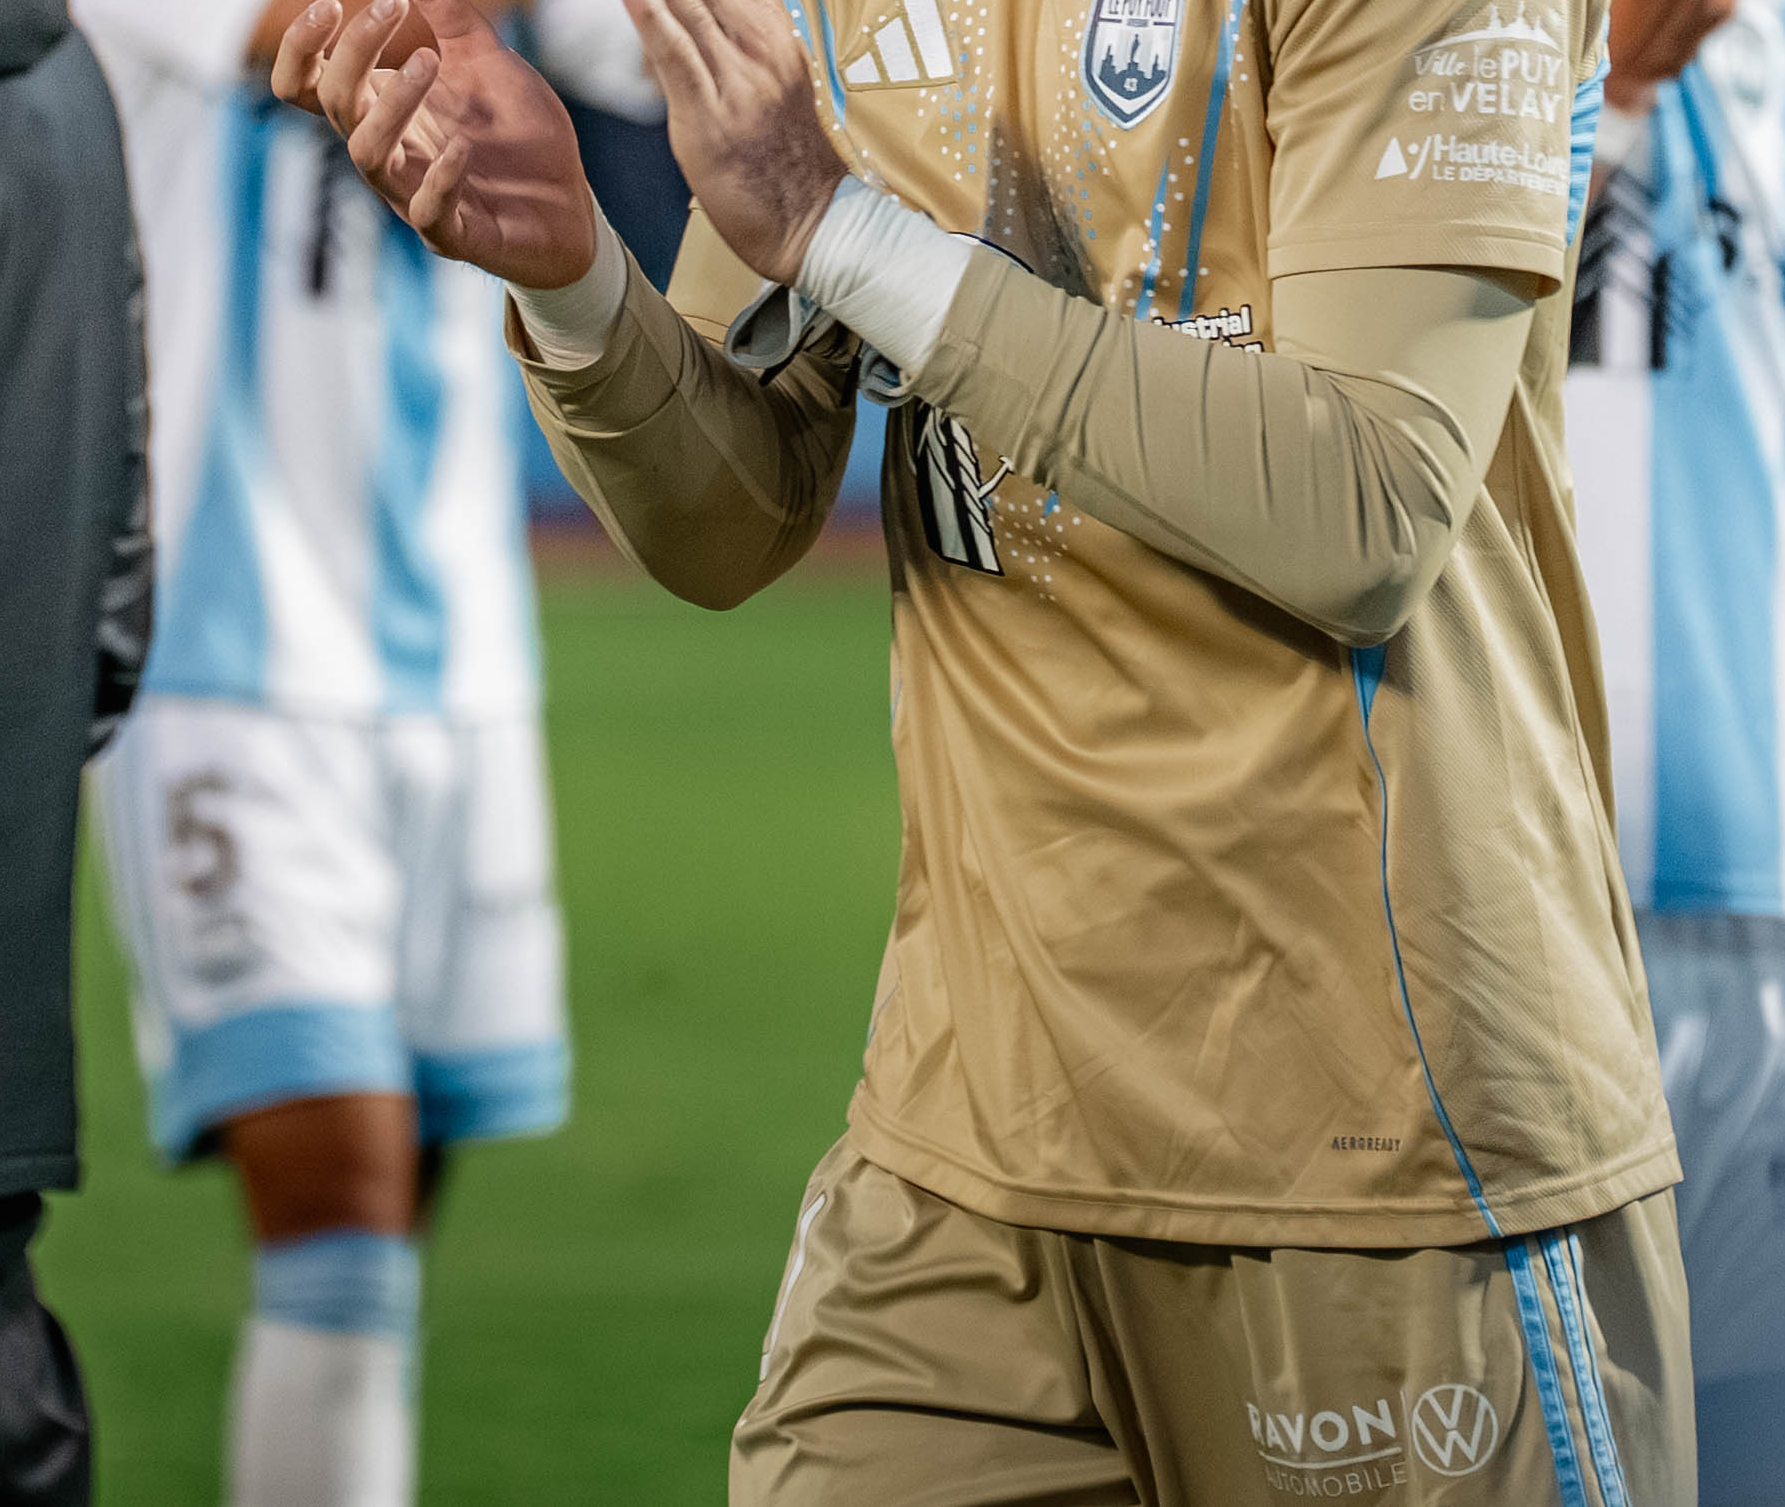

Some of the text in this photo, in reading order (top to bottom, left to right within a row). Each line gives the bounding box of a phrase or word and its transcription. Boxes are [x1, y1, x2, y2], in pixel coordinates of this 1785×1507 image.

[1416, 44, 1562, 87] Ville le PUY
[1408, 81, 1562, 123] en VELAY
[1431, 165, 1456, 182] LE
[165, 769, 241, 898] 5
[1247, 1398, 1397, 1454] RAVON
